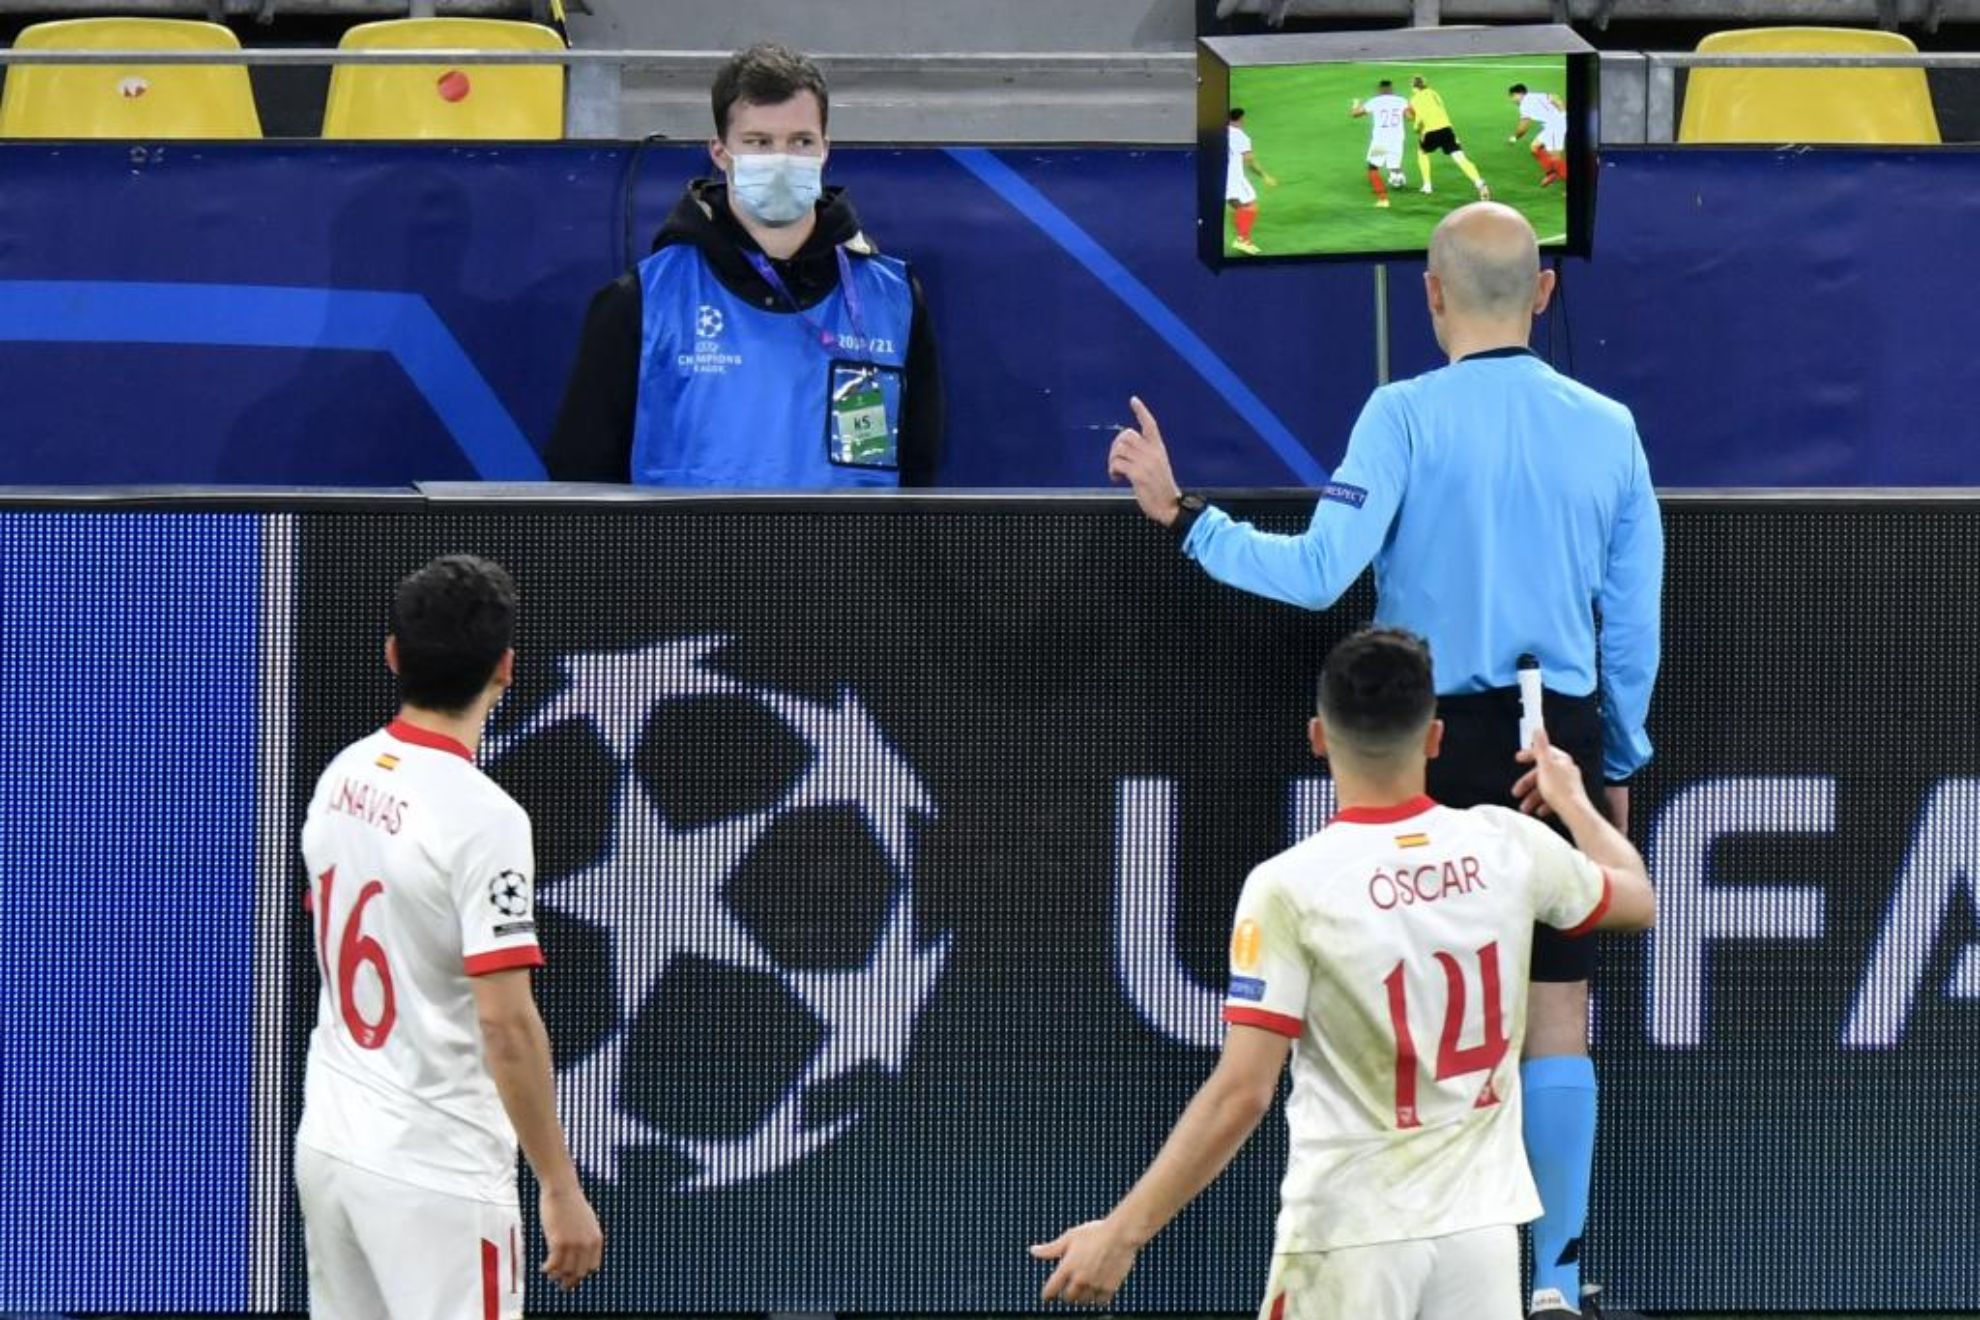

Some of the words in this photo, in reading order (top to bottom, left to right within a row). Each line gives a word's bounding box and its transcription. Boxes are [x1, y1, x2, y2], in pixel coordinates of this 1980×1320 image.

[319, 864, 396, 1050] 16
[1368, 856, 1486, 910] ÓSCAR
[1383, 940, 1511, 1130] 14
